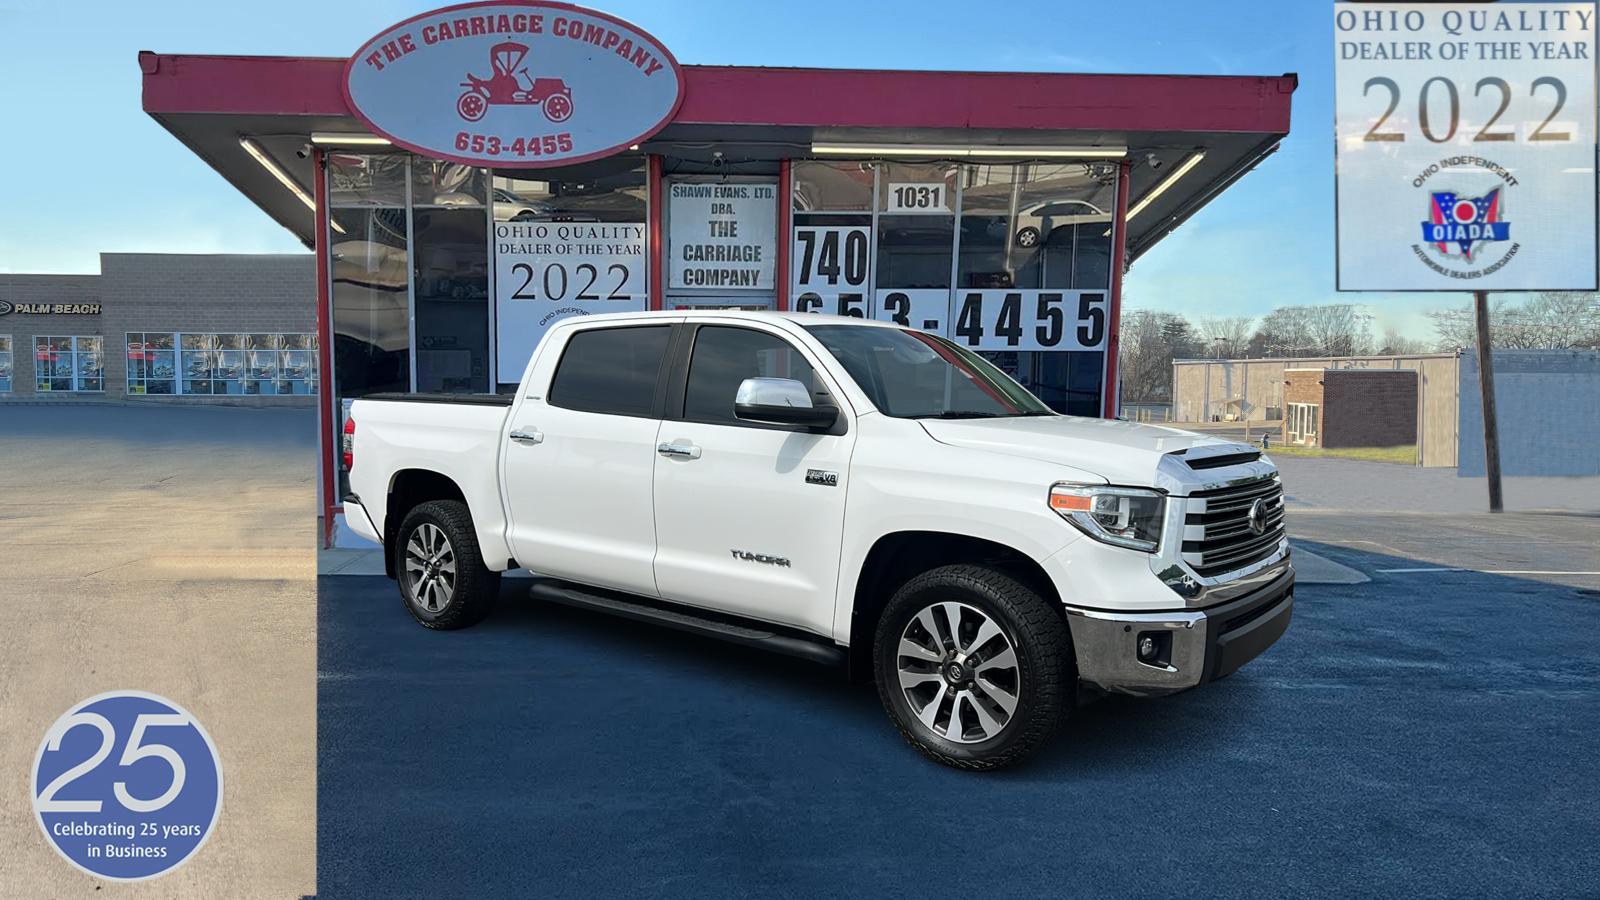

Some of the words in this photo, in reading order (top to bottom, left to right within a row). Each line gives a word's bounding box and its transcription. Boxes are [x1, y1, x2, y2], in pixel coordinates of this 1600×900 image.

[1336, 10, 1424, 31] OHIO
[1442, 10, 1592, 36] QUALITY
[366, 33, 416, 71] THE
[422, 14, 543, 45] CARRIAGE
[552, 17, 664, 77] COMPANY
[1340, 42, 1432, 60] DEALER
[1438, 42, 1469, 60] OF
[1475, 42, 1521, 60] THE
[1528, 42, 1588, 60] YEAR
[1363, 76, 1570, 143] 2022
[454, 132, 573, 156] 653-4455
[1412, 164, 1439, 188] OHIO
[1440, 156, 1519, 187] INDEPENDENT
[673, 185, 712, 198] SHAWN
[754, 187, 775, 199] LTD.
[895, 186, 940, 209] 1031
[711, 203, 736, 215] DBA.
[497, 226, 548, 238] OHIO
[557, 226, 644, 241] QUALITY
[708, 221, 738, 238] THE
[1432, 224, 1495, 240] OIADA
[499, 243, 552, 254] DEALER
[555, 244, 573, 255] OF
[576, 244, 603, 255] THE
[606, 244, 641, 255] YEAR
[683, 244, 762, 262] CARRIAGE
[797, 231, 868, 285] 740
[511, 262, 632, 300] 2022
[683, 268, 761, 286] COMPANY
[1450, 269, 1482, 280] DEALERS
[14, 303, 51, 314] PALM
[54, 303, 100, 314] BEACH
[539, 311, 555, 326] OHIO
[730, 549, 791, 568] TUNDRA
